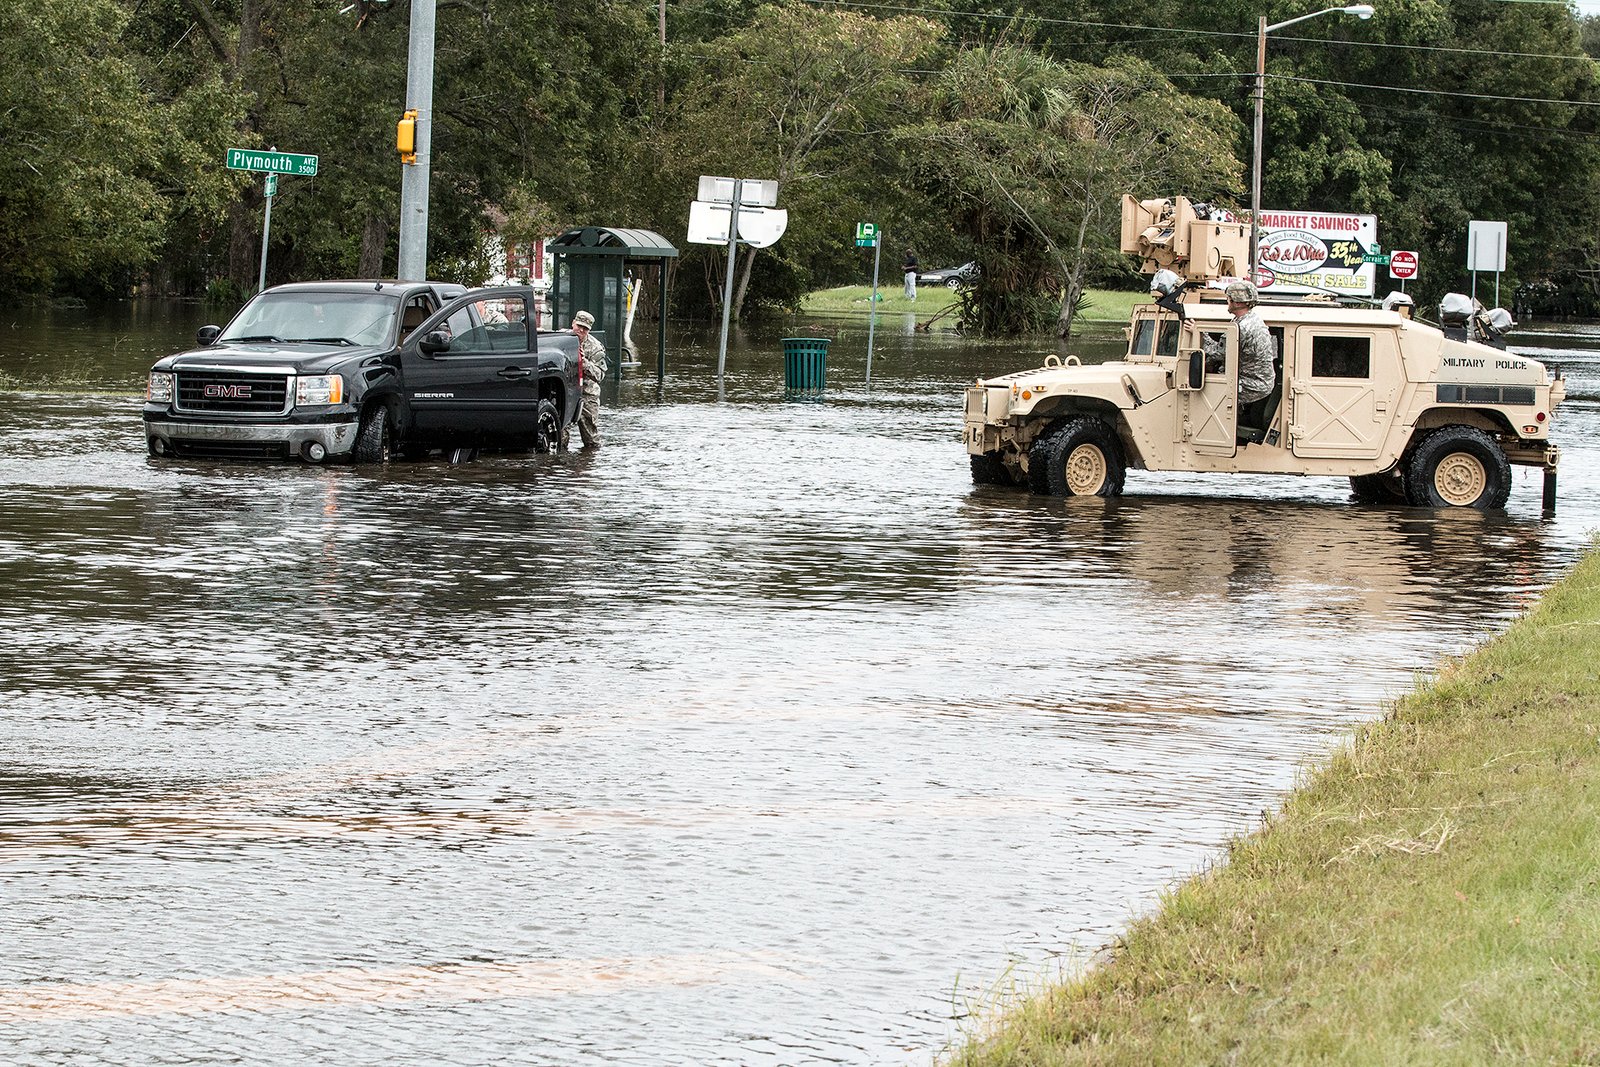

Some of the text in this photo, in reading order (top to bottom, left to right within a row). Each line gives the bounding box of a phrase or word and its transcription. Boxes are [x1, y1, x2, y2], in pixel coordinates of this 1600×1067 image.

[233, 152, 292, 170] Plymouth
[303, 157, 315, 166] AVE
[298, 165, 315, 174] 3500
[1311, 216, 1360, 231] SAVINGS
[1299, 233, 1319, 246] Market
[1258, 244, 1326, 261] Red & White
[1329, 241, 1358, 258] 35th
[1275, 264, 1291, 272] SINCE
[1275, 273, 1367, 289] MEAT SALE
[1443, 358, 1527, 370] MILITARY POLICE
[204, 384, 252, 398] GMC
